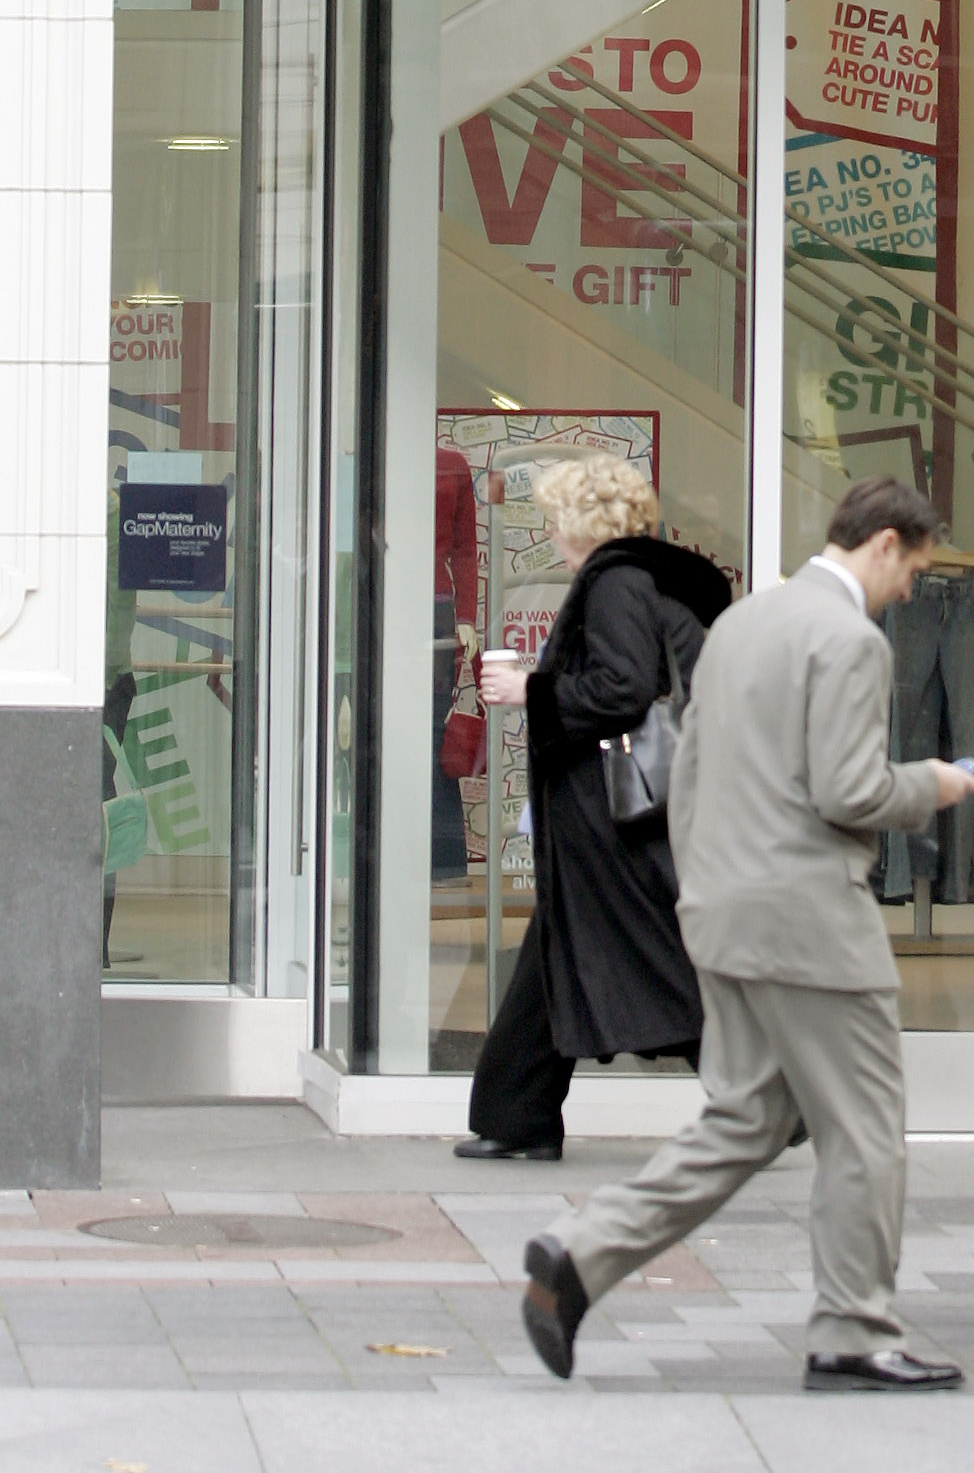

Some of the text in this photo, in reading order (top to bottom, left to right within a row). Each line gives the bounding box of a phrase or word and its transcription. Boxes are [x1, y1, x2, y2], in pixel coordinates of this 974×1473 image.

[834, 2, 909, 40] IDEA
[828, 30, 867, 57] TIE
[871, 41, 889, 62] A
[604, 37, 701, 94] TO
[824, 57, 933, 96] AROUND
[822, 82, 890, 114] CUTE
[837, 154, 892, 183] NO.
[818, 187, 872, 216] PJ'S
[876, 178, 912, 203] TO
[572, 264, 692, 307] GIFT
[110, 338, 183, 362] COMI
[123, 519, 222, 541] GapMaternity
